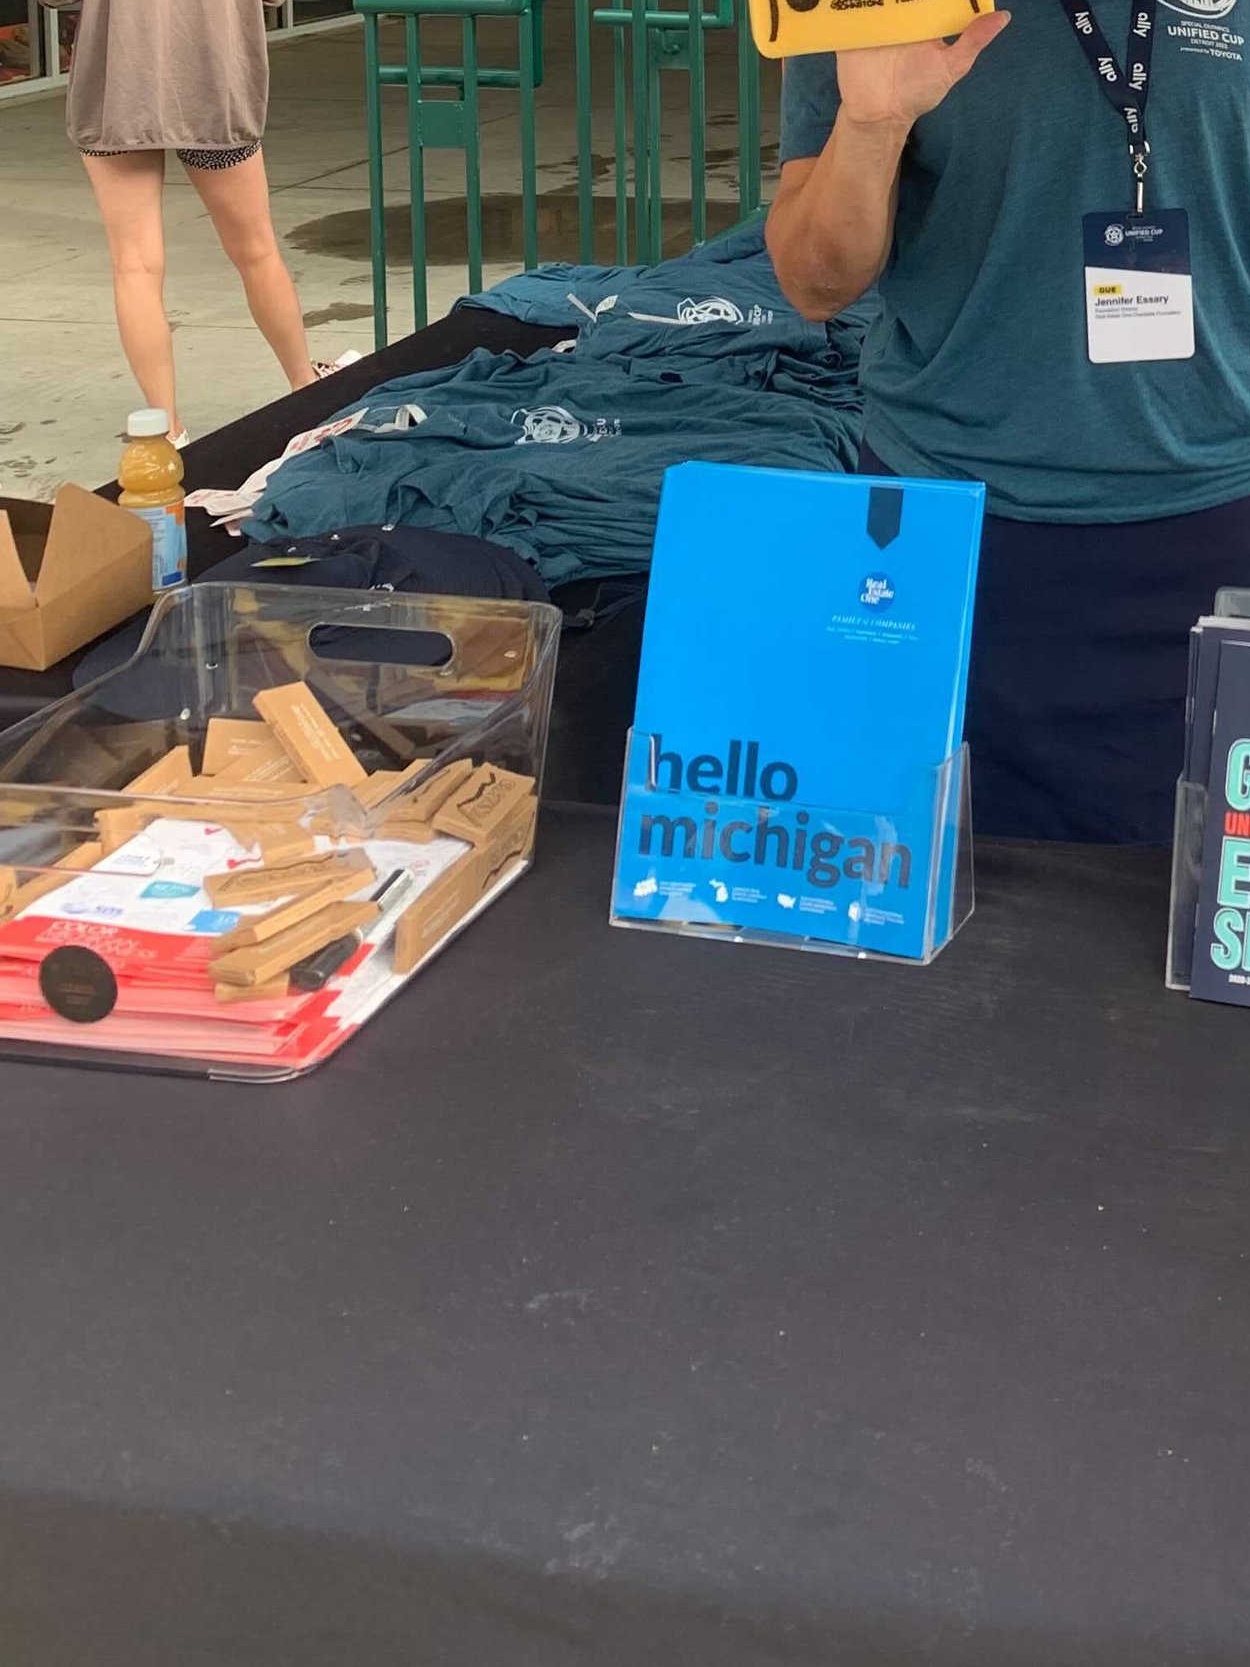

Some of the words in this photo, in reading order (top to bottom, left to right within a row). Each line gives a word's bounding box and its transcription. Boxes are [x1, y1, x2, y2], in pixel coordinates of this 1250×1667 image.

[1074, 10, 1094, 36] ally
[1132, 11, 1152, 38] ally
[1167, 25, 1220, 41] UNIFIED
[1221, 33, 1245, 46] CUP
[1209, 48, 1243, 61] TOYOTA
[1097, 56, 1117, 83] ally
[1128, 62, 1147, 91] ally
[1124, 107, 1138, 134] ally
[1094, 296, 1134, 307] Jennifer
[1136, 295, 1169, 304] Essary
[648, 734, 799, 803] hello
[637, 801, 913, 890] michigan
